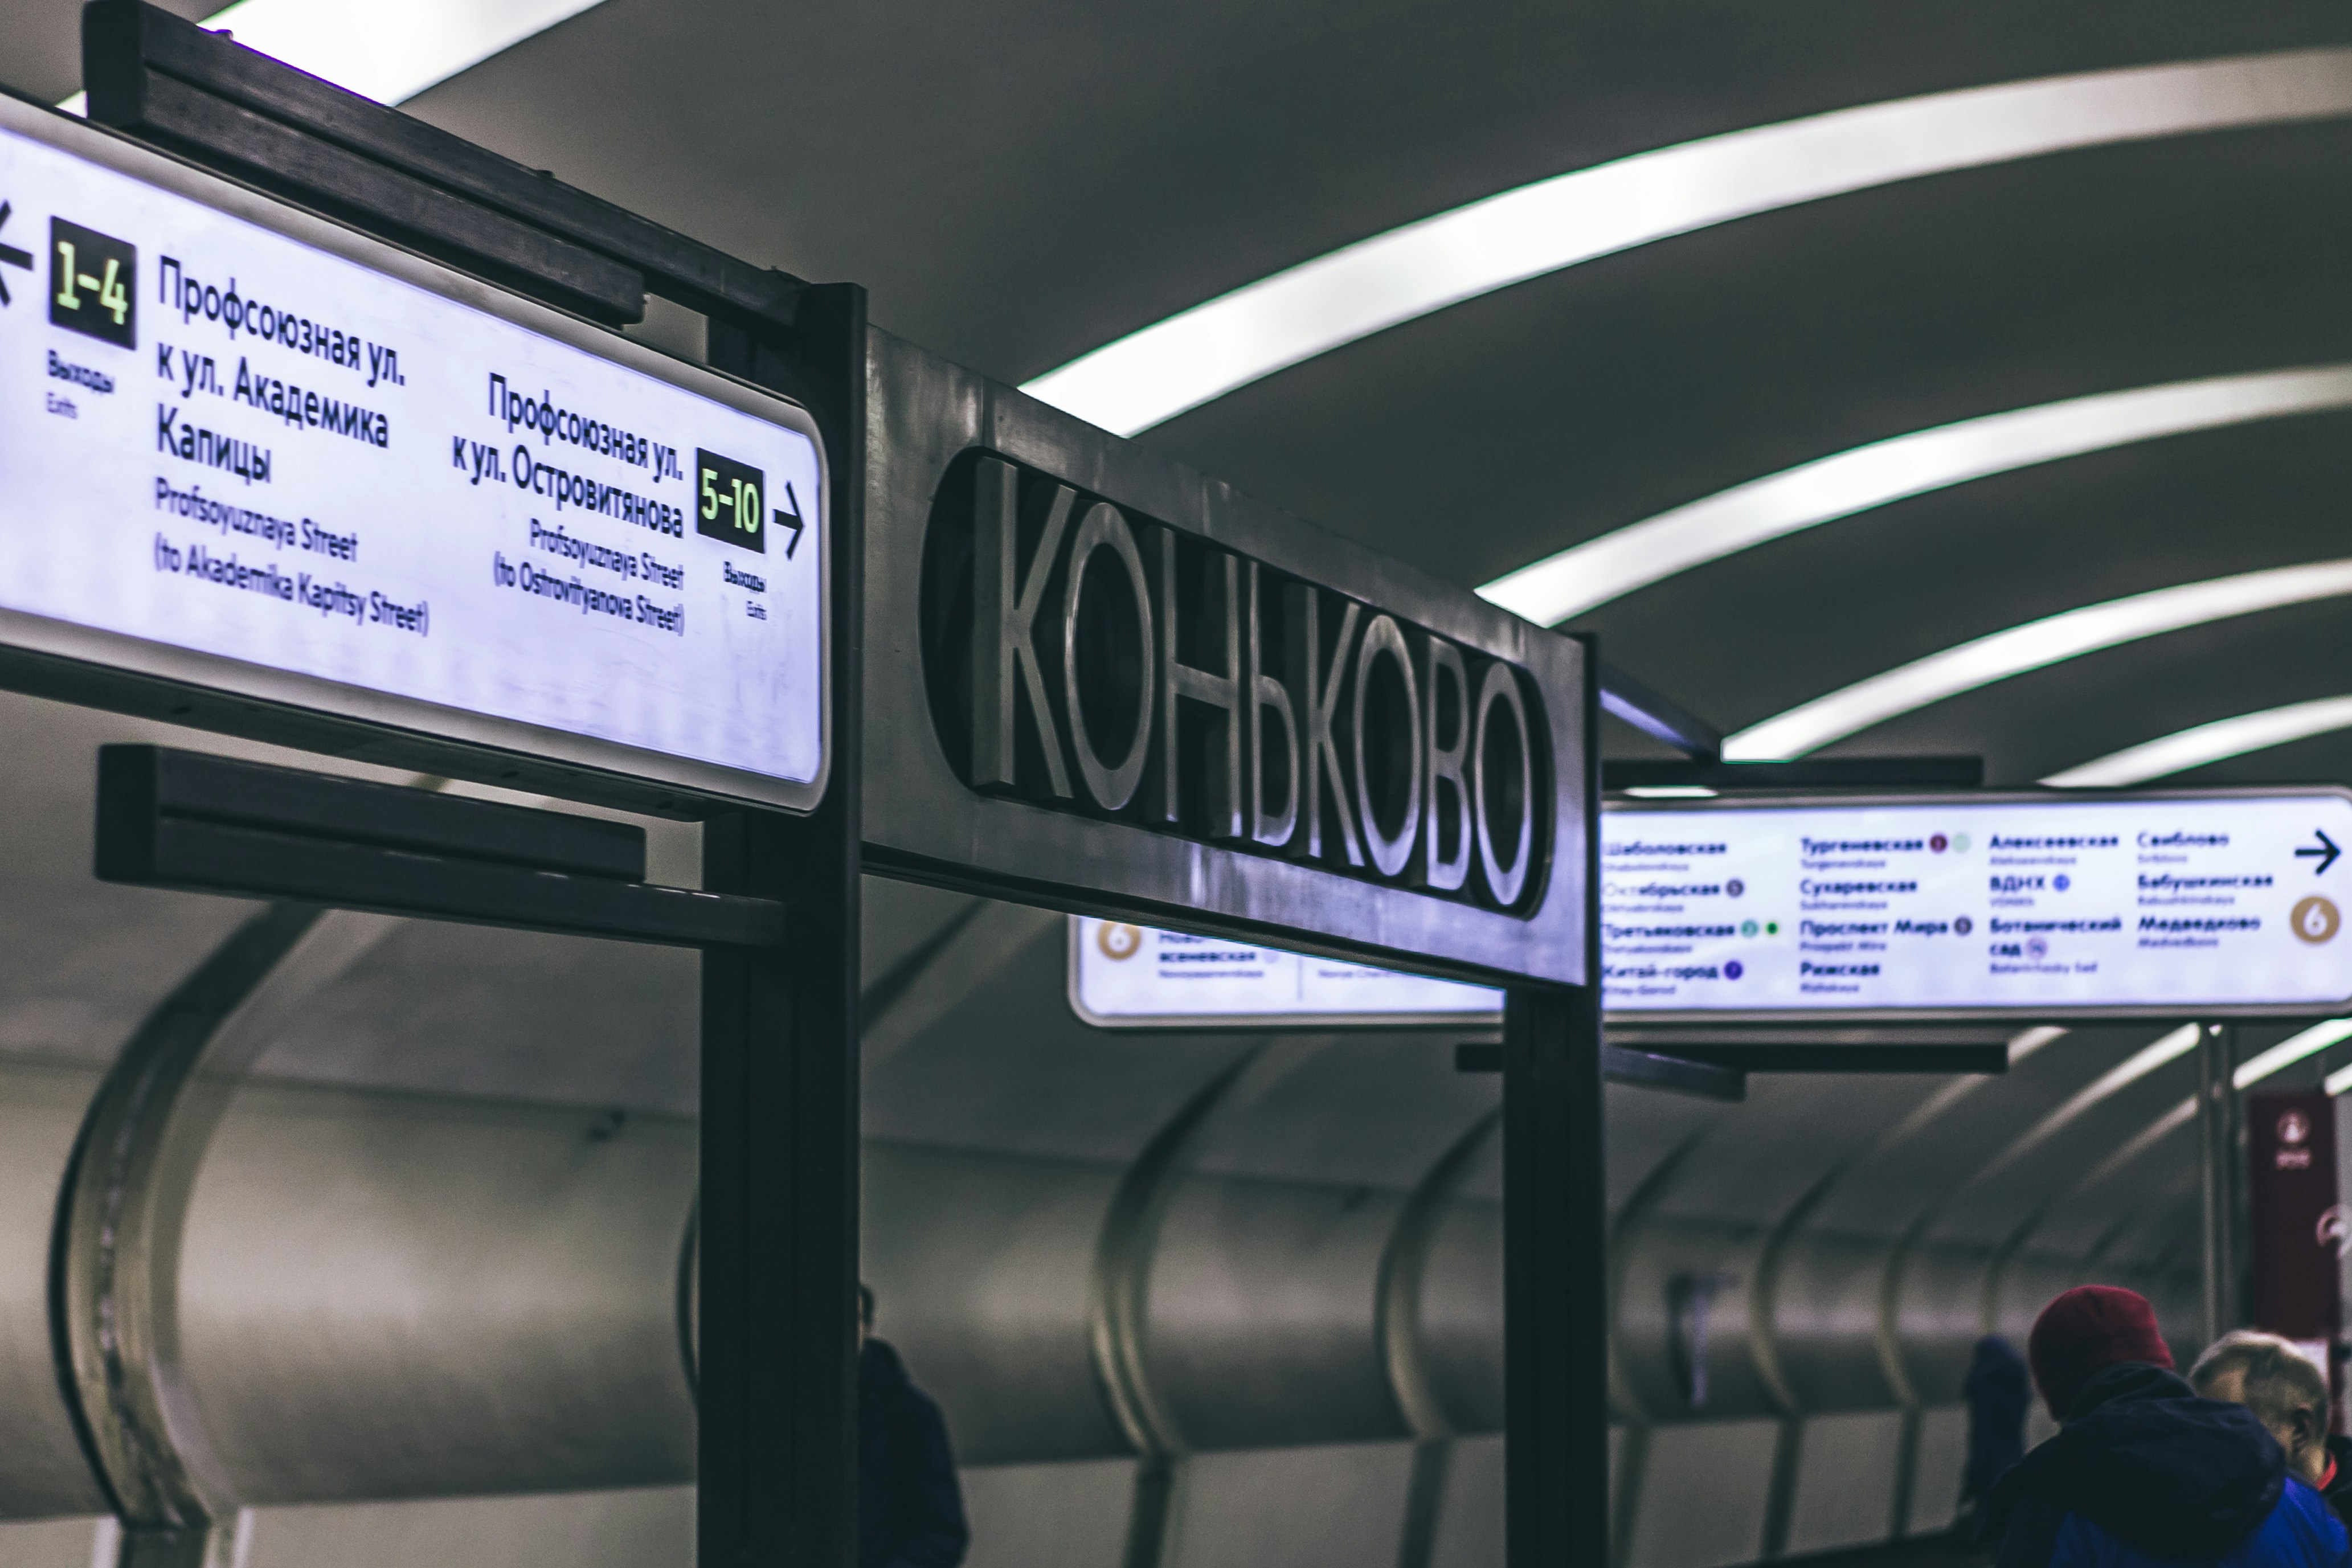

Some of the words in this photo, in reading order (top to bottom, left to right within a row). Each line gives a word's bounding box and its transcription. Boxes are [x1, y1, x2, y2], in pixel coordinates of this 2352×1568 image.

[159, 254, 361, 371] Профсоюзная
[367, 341, 406, 388] ул.
[158, 343, 174, 380] к
[182, 349, 224, 398] ул.
[233, 356, 389, 449] Академика
[489, 371, 649, 469] Профсоюзная
[652, 442, 684, 484] ул.
[158, 402, 272, 486] Капицы
[453, 436, 468, 471] к
[471, 441, 507, 486] ул.
[512, 444, 684, 539] Островитянова
[156, 476, 295, 551] Profsoyuznaya
[301, 518, 358, 563] Street
[701, 468, 760, 534] 5-10
[154, 532, 182, 572] (to
[185, 544, 293, 602] Akademika
[298, 572, 367, 627] Kapitsy
[370, 590, 430, 638] Street)
[494, 550, 516, 587] (to
[520, 562, 633, 620] Ostrovityanova
[636, 594, 685, 637] Street)
[530, 518, 638, 582] Profsoyuznaya
[640, 552, 685, 591] Street
[973, 456, 1534, 907] КОНЬКОВО
[2303, 902, 2327, 936] 6
